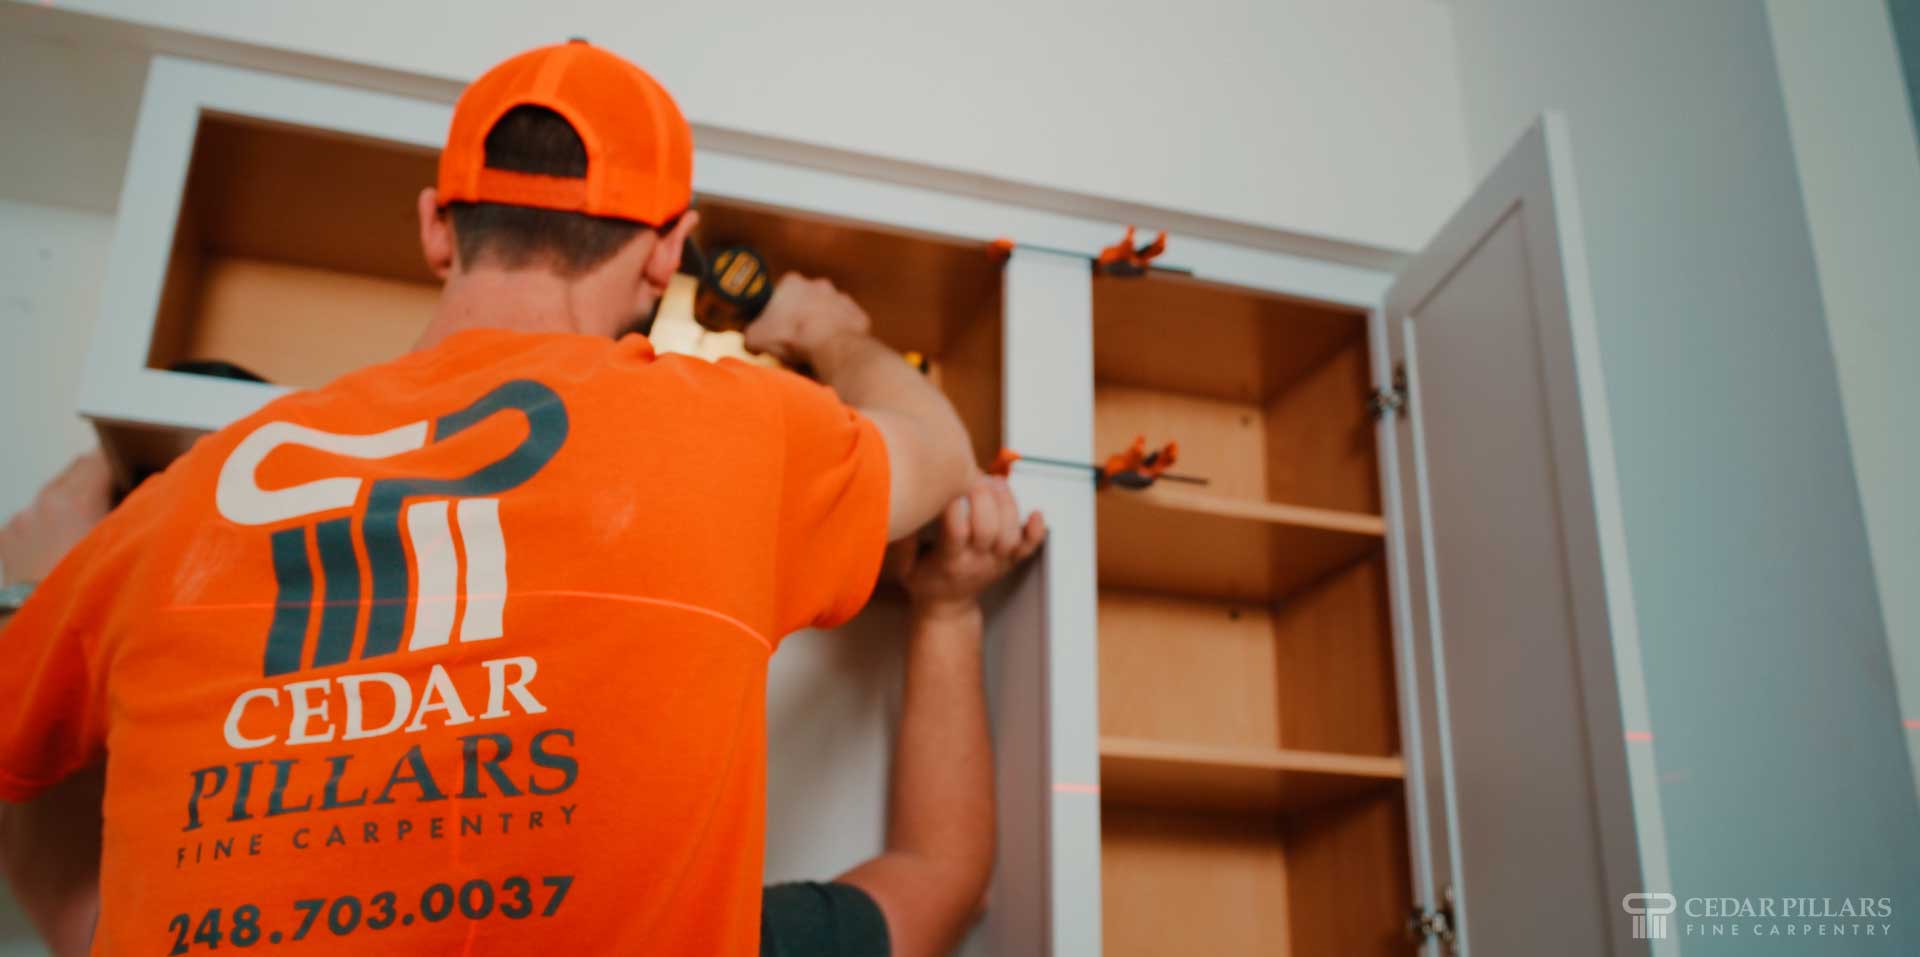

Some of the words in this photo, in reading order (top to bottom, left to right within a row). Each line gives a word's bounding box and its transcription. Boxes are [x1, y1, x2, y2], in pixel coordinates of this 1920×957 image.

[223, 656, 547, 749] CEDAR
[181, 728, 579, 832] PILLARS
[177, 834, 262, 868] FINE
[292, 804, 577, 850] CARPENTRY
[167, 876, 575, 957] 248.703.0037
